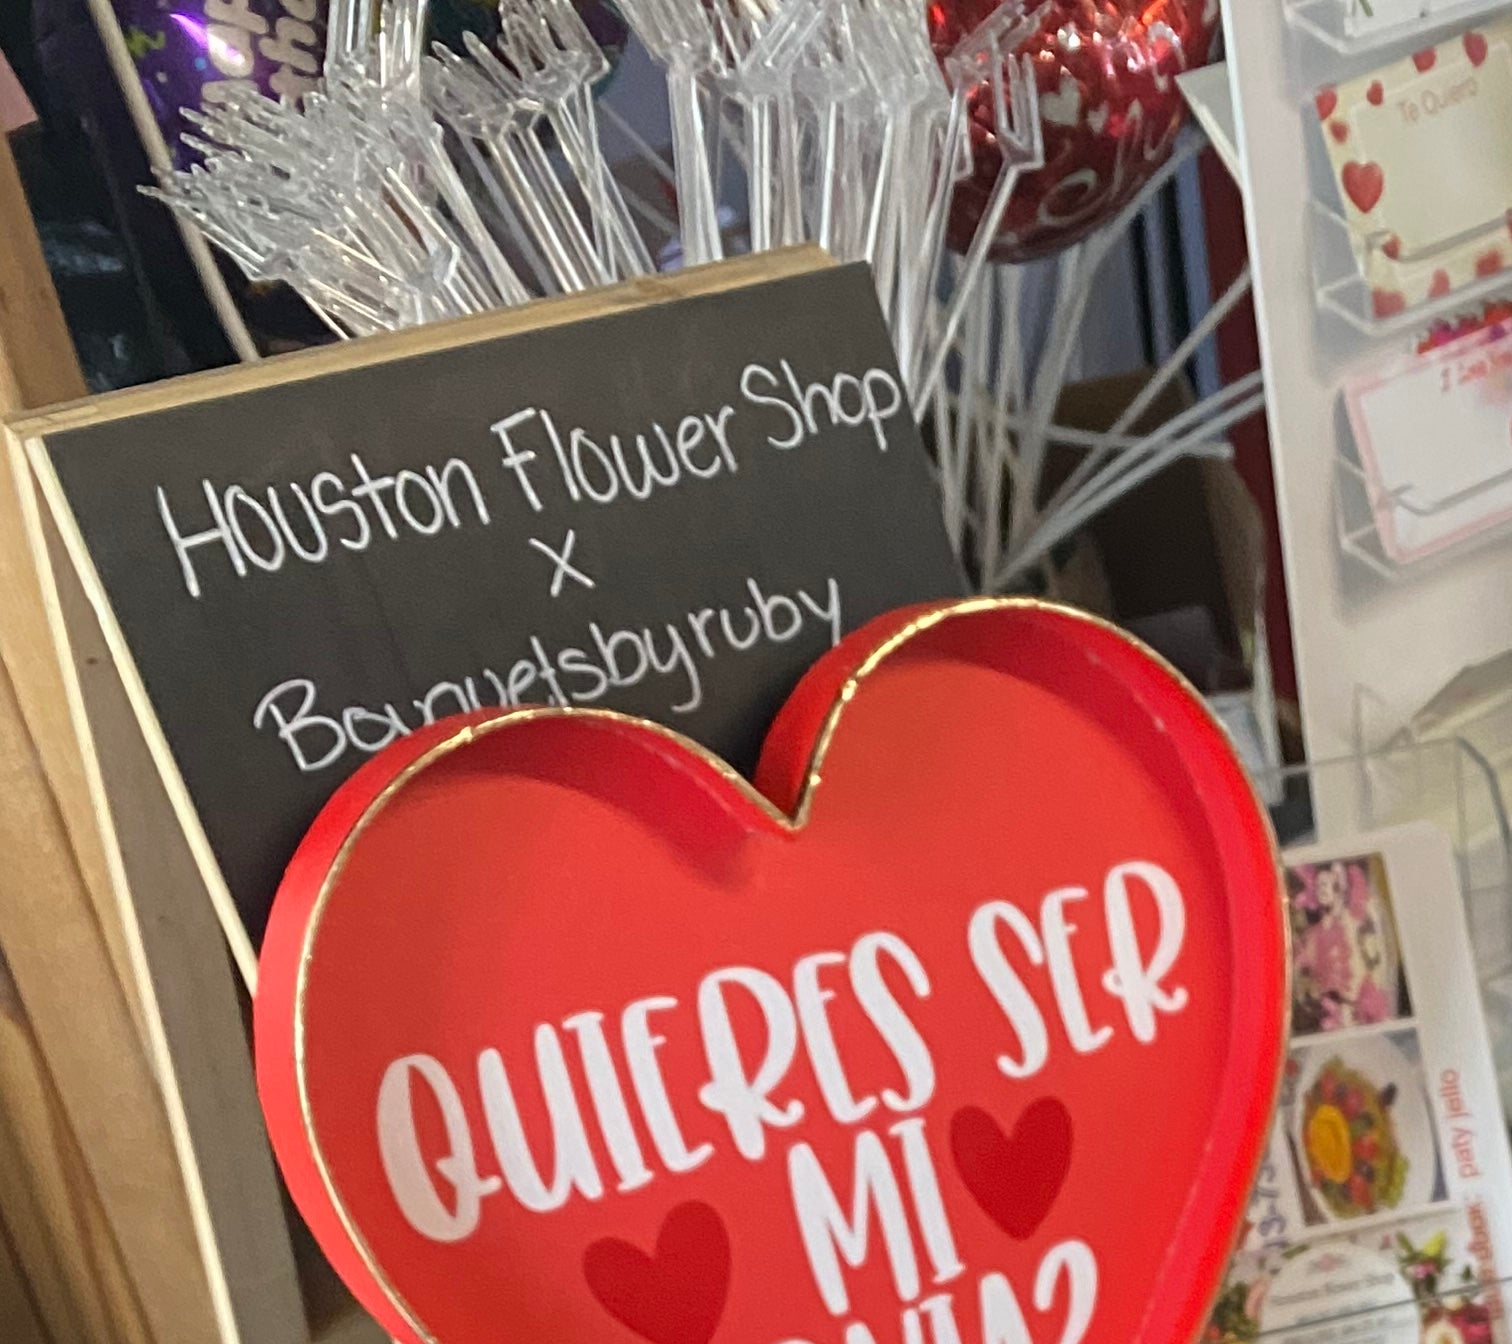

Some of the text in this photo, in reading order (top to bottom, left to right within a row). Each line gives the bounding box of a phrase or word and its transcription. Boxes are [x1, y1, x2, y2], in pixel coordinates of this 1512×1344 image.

[157, 359, 900, 597] Houston Flower Shop
[376, 859, 1188, 1243] QUIERES SER
[786, 1118, 965, 1317] MI
